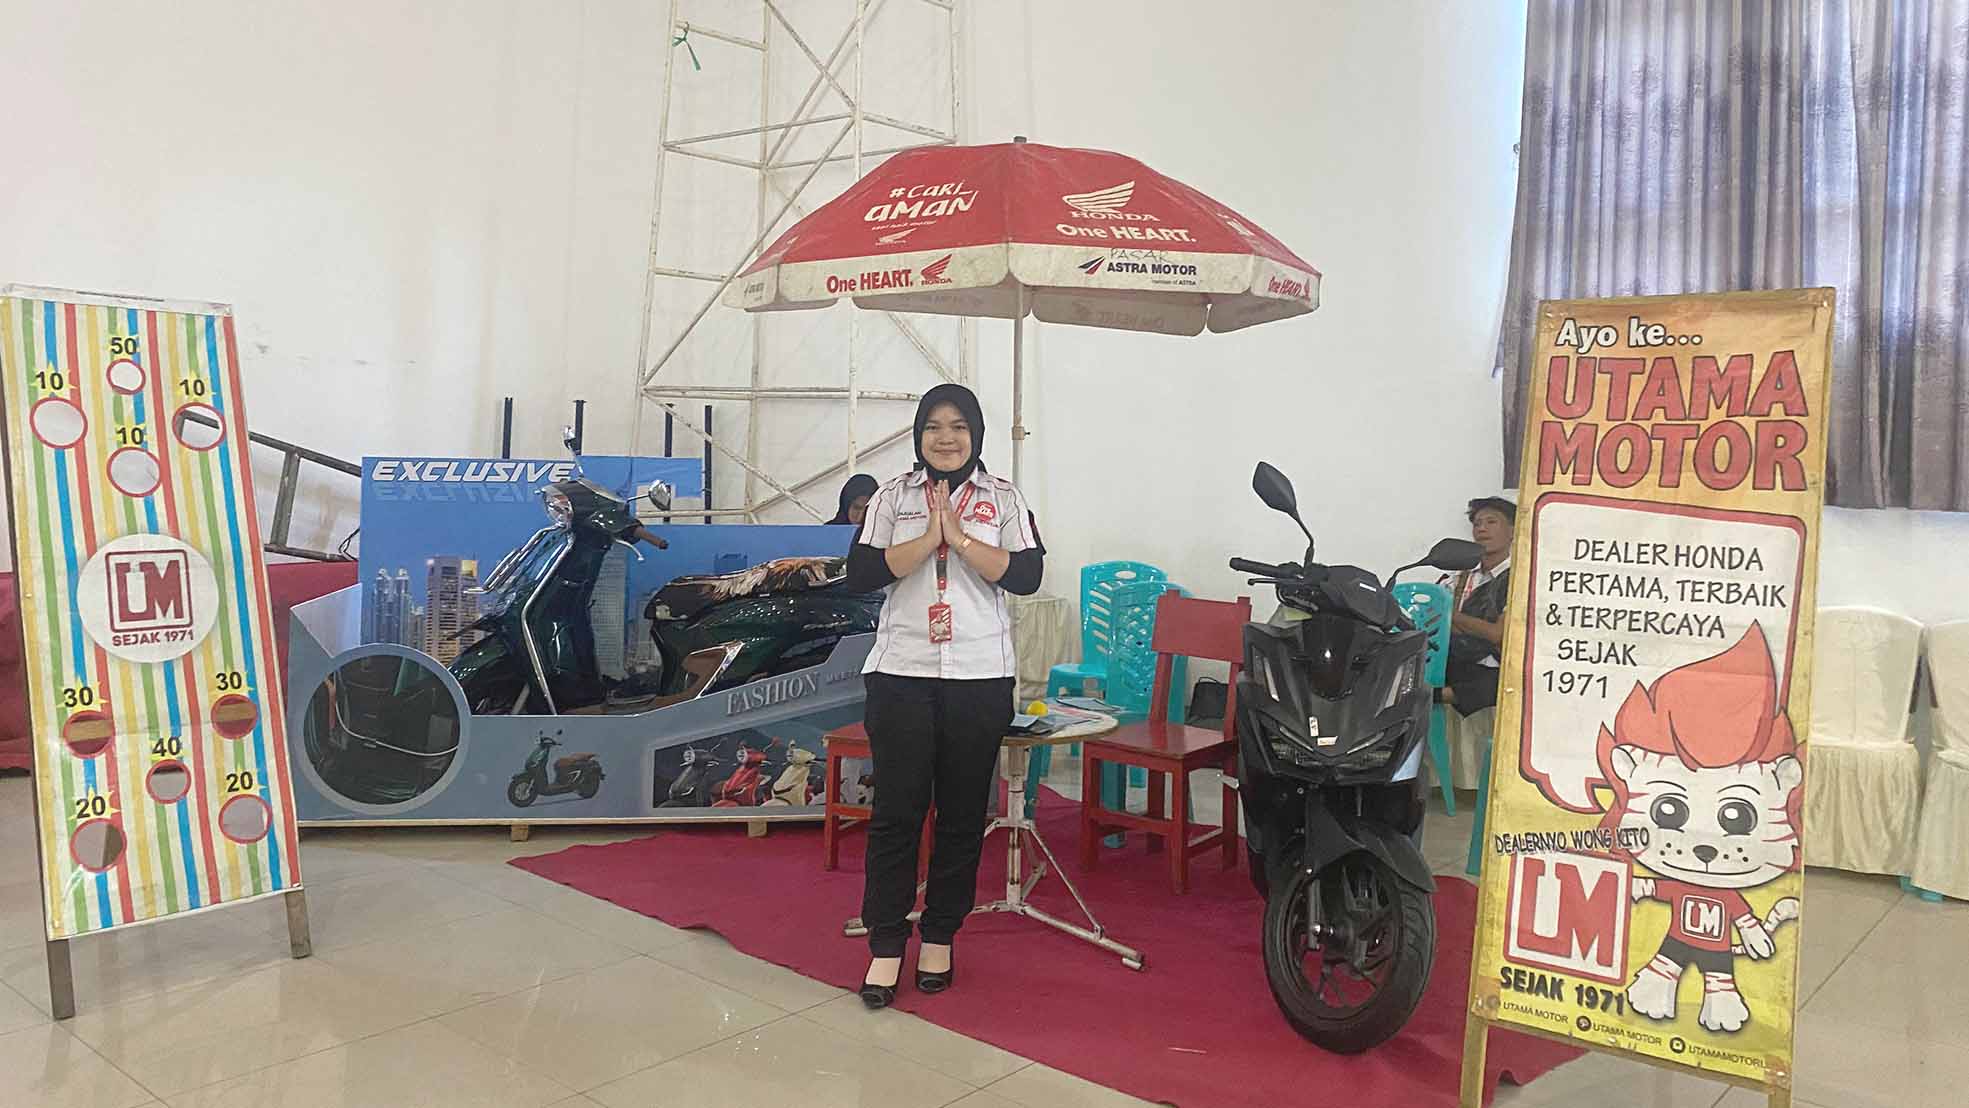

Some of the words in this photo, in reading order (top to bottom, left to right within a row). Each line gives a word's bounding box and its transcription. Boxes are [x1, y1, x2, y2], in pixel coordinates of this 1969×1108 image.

[1070, 211, 1160, 221] HONDA
[1056, 223, 1108, 238] One
[1109, 226, 1197, 242] HEART.
[1107, 262, 1148, 273] ASTRA
[1151, 263, 1197, 275] MOTOR
[826, 275, 856, 293] One
[860, 269, 913, 290] HEART.
[921, 277, 952, 286] HONDA
[111, 336, 137, 355] 50
[1555, 318, 1618, 354] Ayo
[1628, 316, 1702, 347] ke...
[35, 371, 64, 391] 10
[180, 378, 205, 396] 10
[1546, 350, 1808, 421] UTAMA
[116, 427, 143, 445] 10
[1537, 419, 1808, 491] MOTOR
[371, 460, 577, 482] EXCLUSIVE
[1574, 538, 1669, 567] DEALER
[1674, 544, 1764, 571] HONDA
[1548, 570, 1669, 604] PERTAMA,
[1676, 579, 1786, 608] TERBAIK
[1545, 603, 1563, 626] &
[1567, 606, 1726, 639] TERPERCAYA
[112, 633, 163, 647] SEJAK
[165, 630, 195, 643] 1971
[1557, 638, 1638, 666] SEJAK
[216, 671, 243, 691] 30
[727, 670, 820, 715] FASHION
[1542, 670, 1608, 698] 1971
[63, 686, 94, 707] 30
[151, 736, 182, 757] 40
[226, 770, 253, 793] 20
[75, 795, 107, 820] 20
[1495, 831, 1568, 854] DEALERNYO
[1570, 828, 1613, 849] WONG
[1616, 827, 1650, 849] KITO
[1500, 966, 1565, 1002] SEJAK
[1574, 983, 1625, 1017] 1971
[1503, 1001, 1534, 1015] UTAMA
[1534, 1009, 1569, 1025] MOTOR
[1592, 1022, 1626, 1039] UTAMA
[1626, 1030, 1663, 1046] MOTOR
